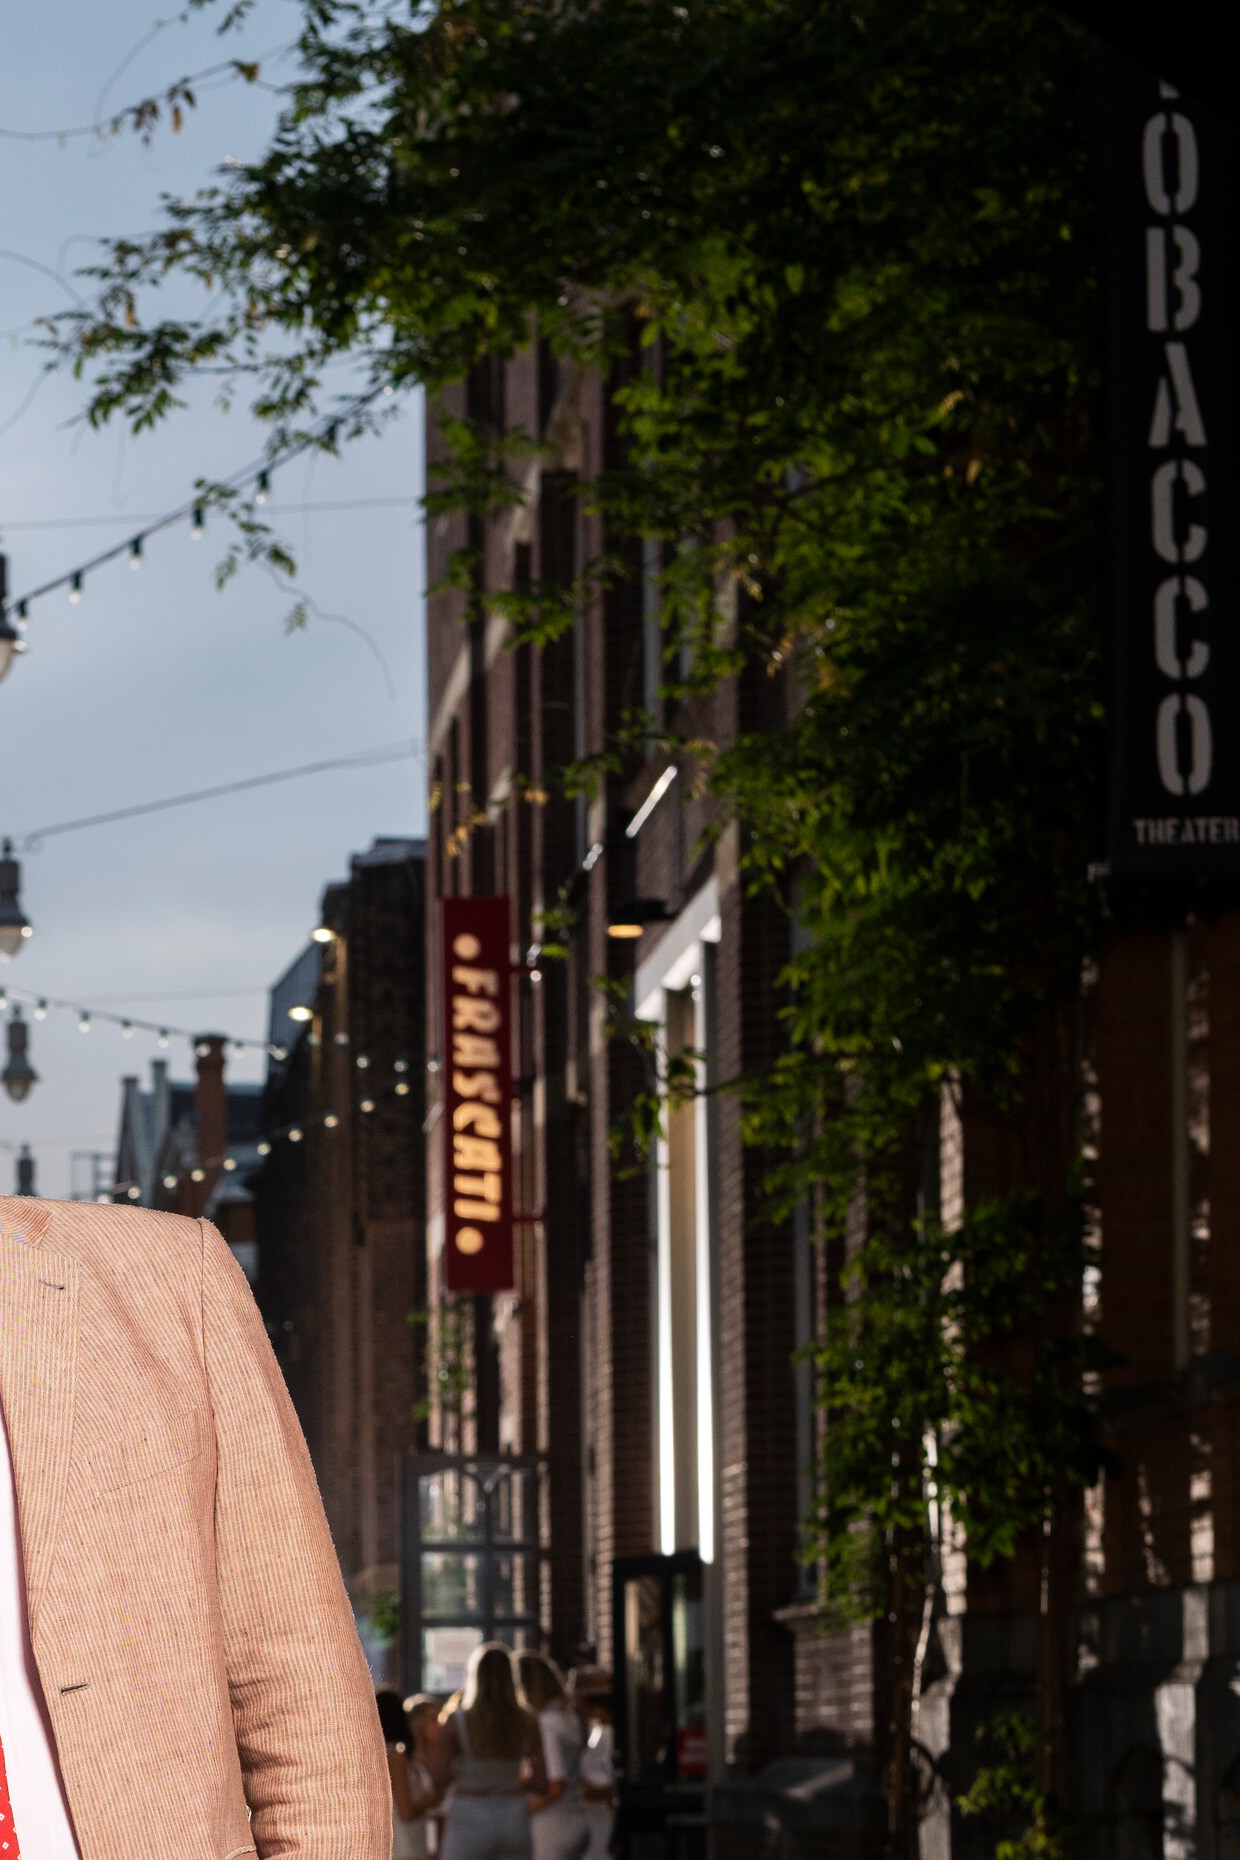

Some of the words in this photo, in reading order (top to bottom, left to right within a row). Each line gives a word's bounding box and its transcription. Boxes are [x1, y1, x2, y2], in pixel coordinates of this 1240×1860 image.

[1141, 76, 1214, 797] OBACCO
[1132, 815, 1240, 847] THEATER
[451, 964, 503, 1223] FRASCATI
